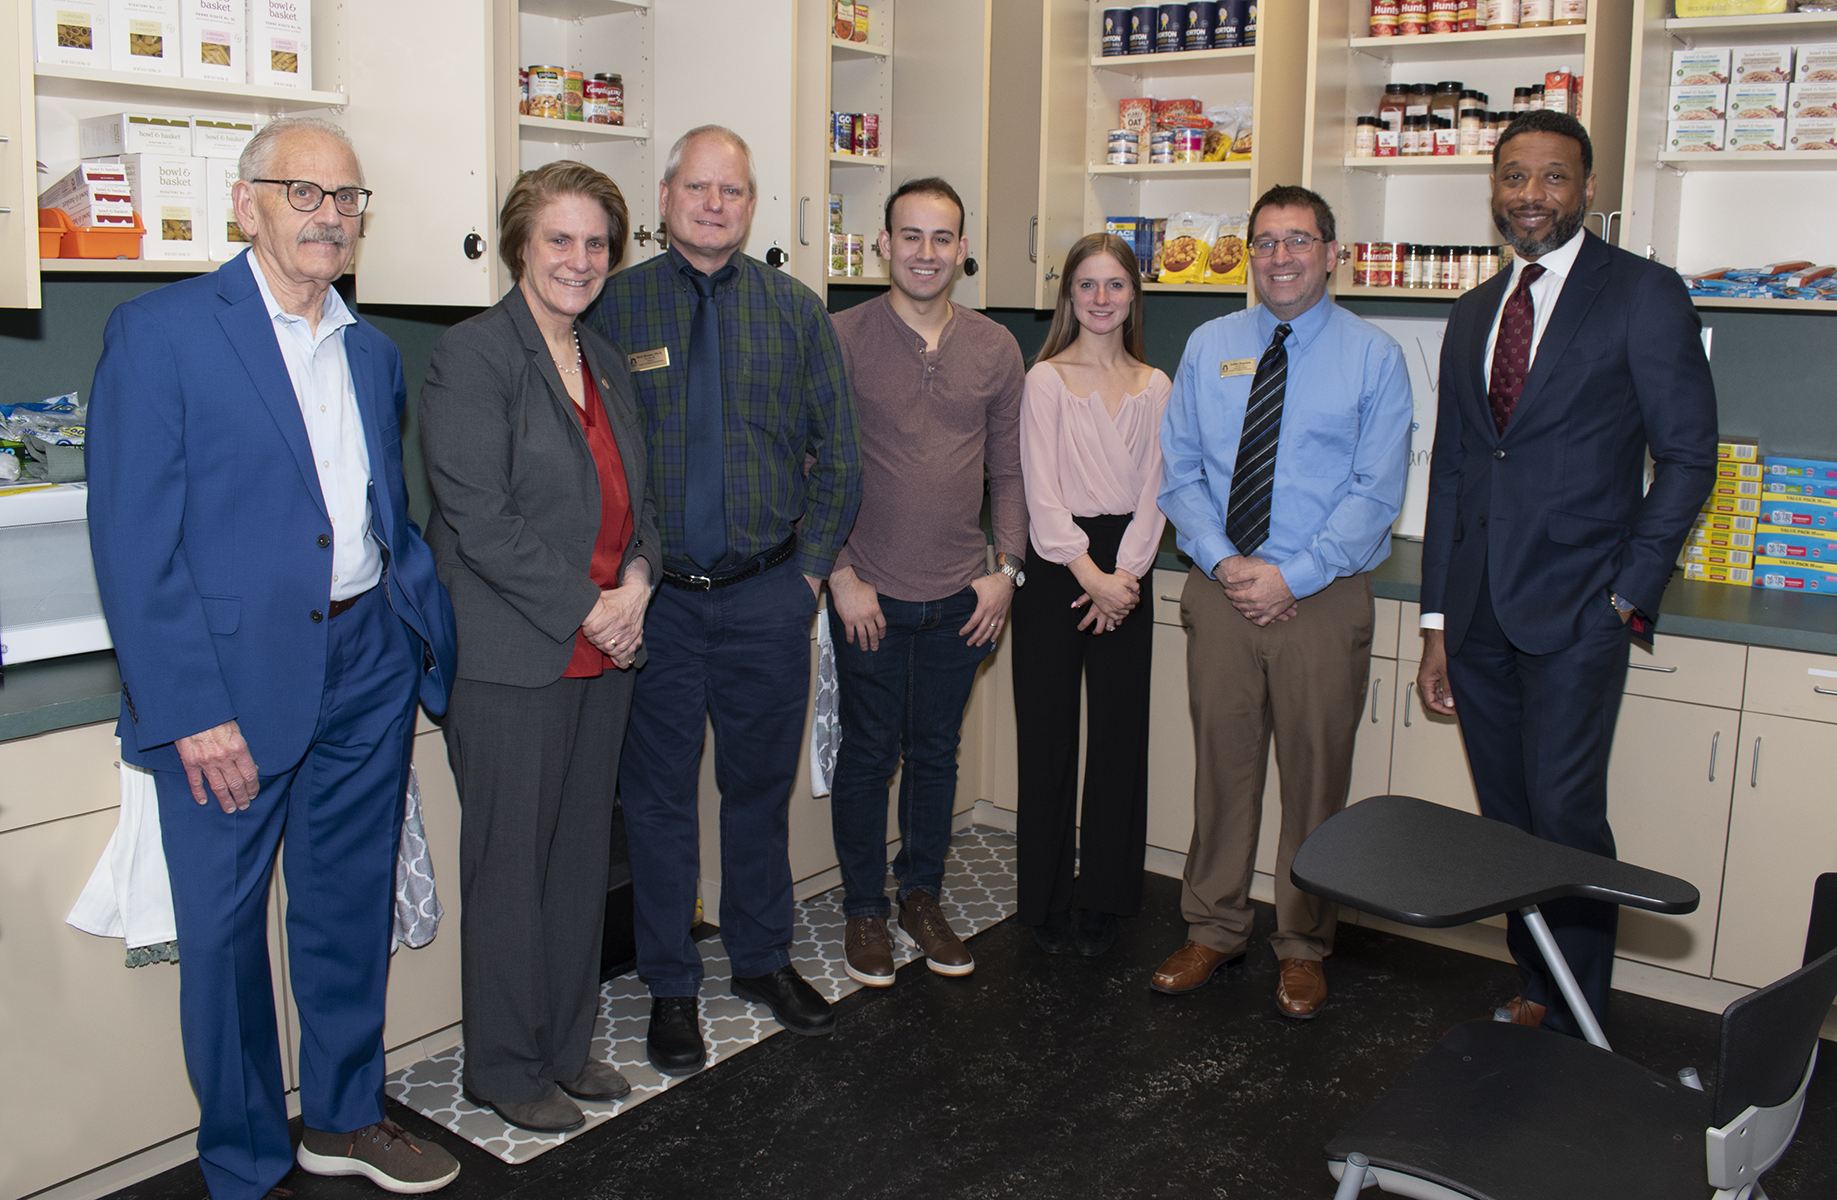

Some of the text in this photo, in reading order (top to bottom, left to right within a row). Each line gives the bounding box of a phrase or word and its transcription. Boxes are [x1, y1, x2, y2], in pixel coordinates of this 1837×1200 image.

[200, 0, 230, 12] basket
[268, 0, 288, 10] bowl
[269, 8, 297, 21] basket
[159, 166, 181, 176] bowl
[159, 176, 192, 186] basket
